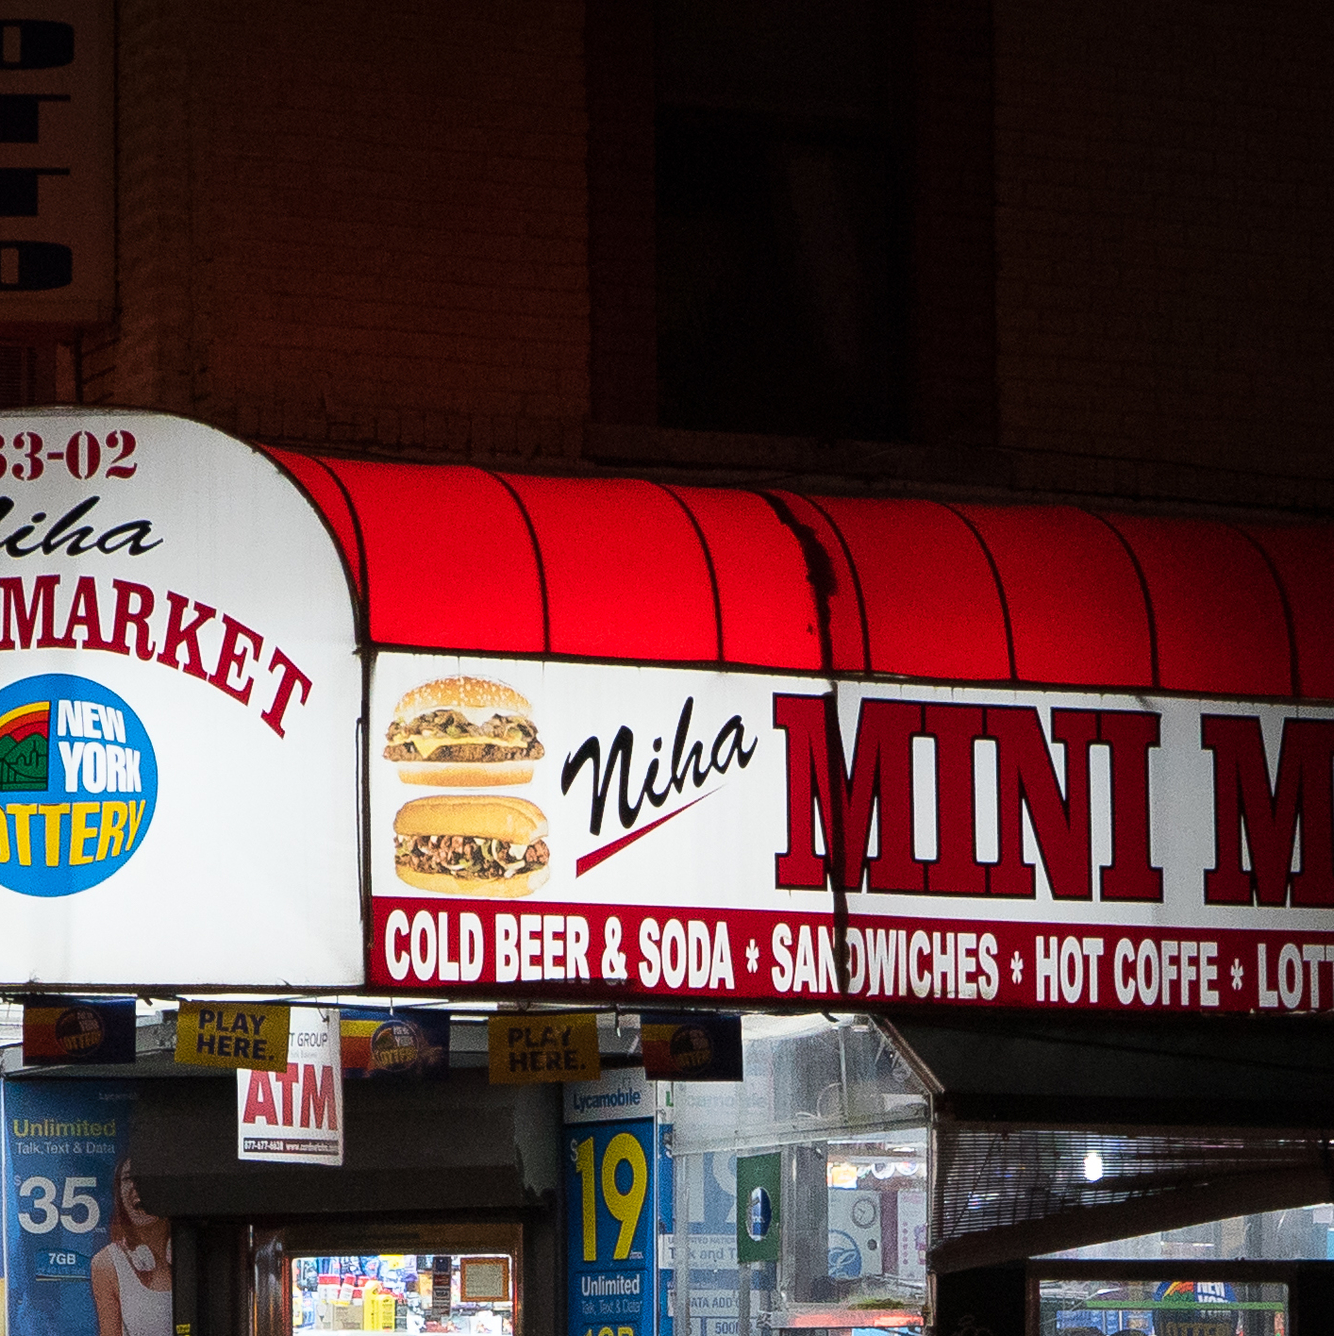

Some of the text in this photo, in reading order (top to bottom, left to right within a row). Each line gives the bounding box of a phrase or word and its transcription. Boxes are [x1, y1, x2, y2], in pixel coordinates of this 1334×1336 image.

[57, 699, 127, 744] NEW
[57, 741, 143, 794] YORK
[560, 695, 759, 837] Niha
[772, 692, 1164, 905] MINI
[384, 907, 484, 984] COLD
[495, 912, 590, 984] BEER
[600, 916, 628, 987] &
[638, 917, 735, 991] SODA
[771, 923, 1000, 1001] SANDWICHES
[1035, 935, 1105, 1004] HOT
[1113, 937, 1220, 1007] COFFE
[198, 1007, 267, 1036] PLAY
[196, 1032, 276, 1062] HERE.
[297, 1032, 328, 1048] GROUP
[507, 1026, 571, 1049] PLAY
[508, 1049, 587, 1074] HERE.
[242, 1062, 339, 1132] ATM
[573, 1086, 642, 1112] Lycamobile
[12, 1118, 117, 1138] Unlimited
[45, 1142, 68, 1154] Text
[85, 1141, 116, 1154] Data
[48, 1252, 77, 1266] 7GB
[581, 1273, 640, 1298] Unlimited
